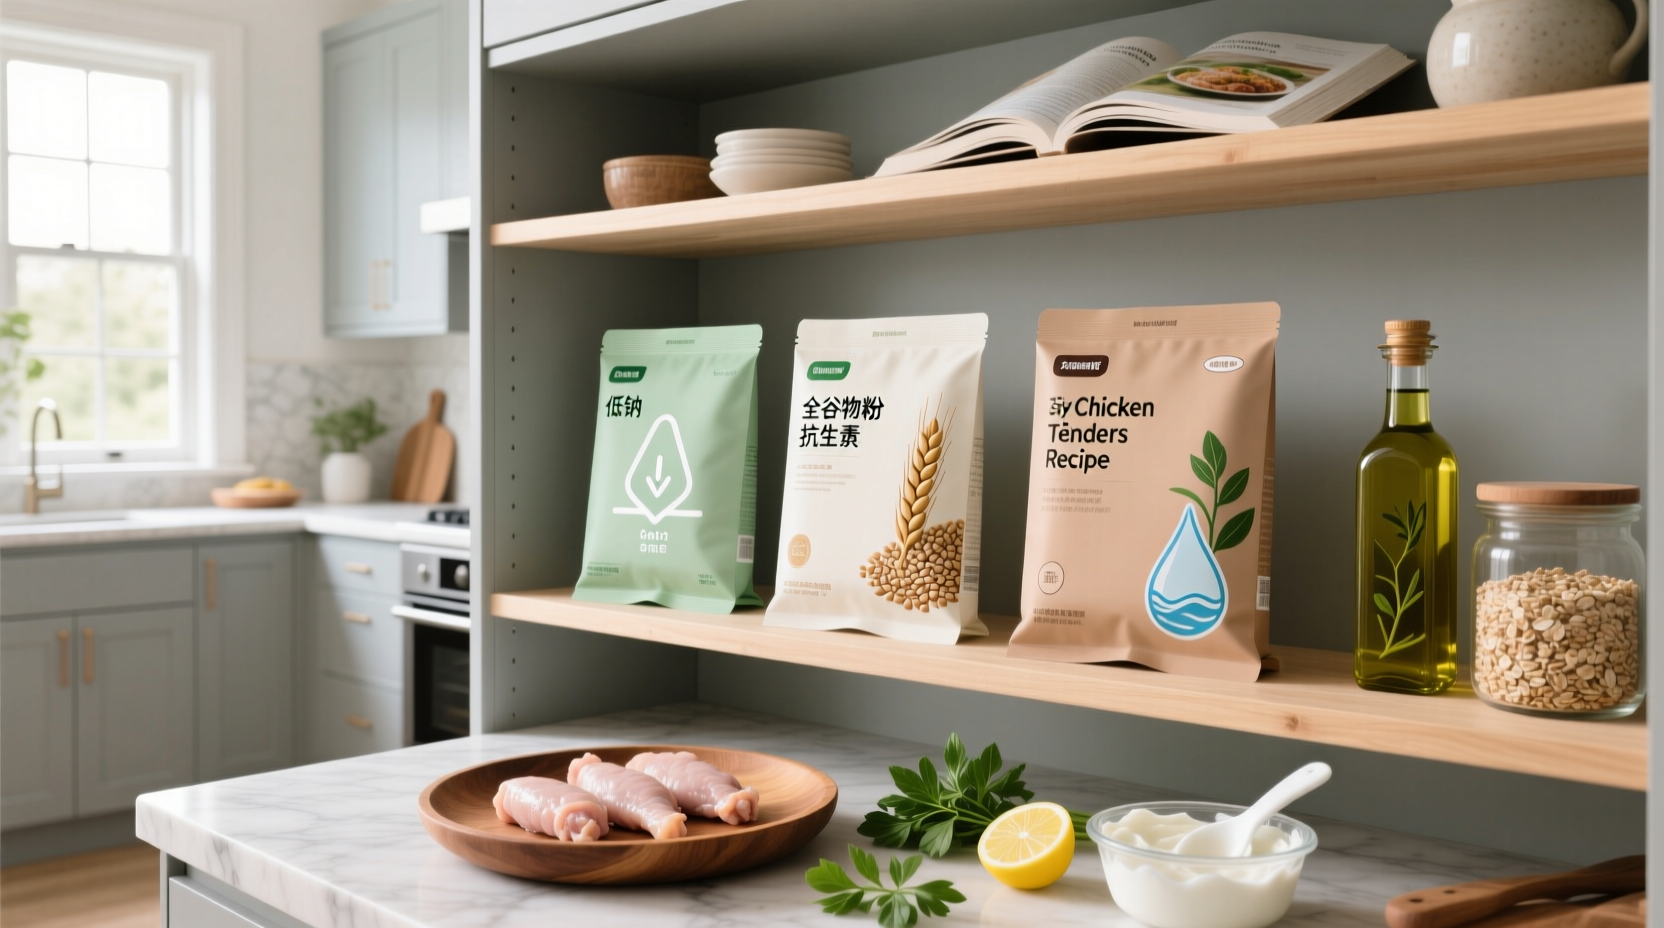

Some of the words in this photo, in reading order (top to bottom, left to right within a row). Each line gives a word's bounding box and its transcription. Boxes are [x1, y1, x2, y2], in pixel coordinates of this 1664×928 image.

[605, 395, 643, 418] 低钠
[802, 395, 884, 420] 全谷物粉
[1074, 396, 1155, 417] Chicken
[1046, 448, 1110, 474] Recipe
